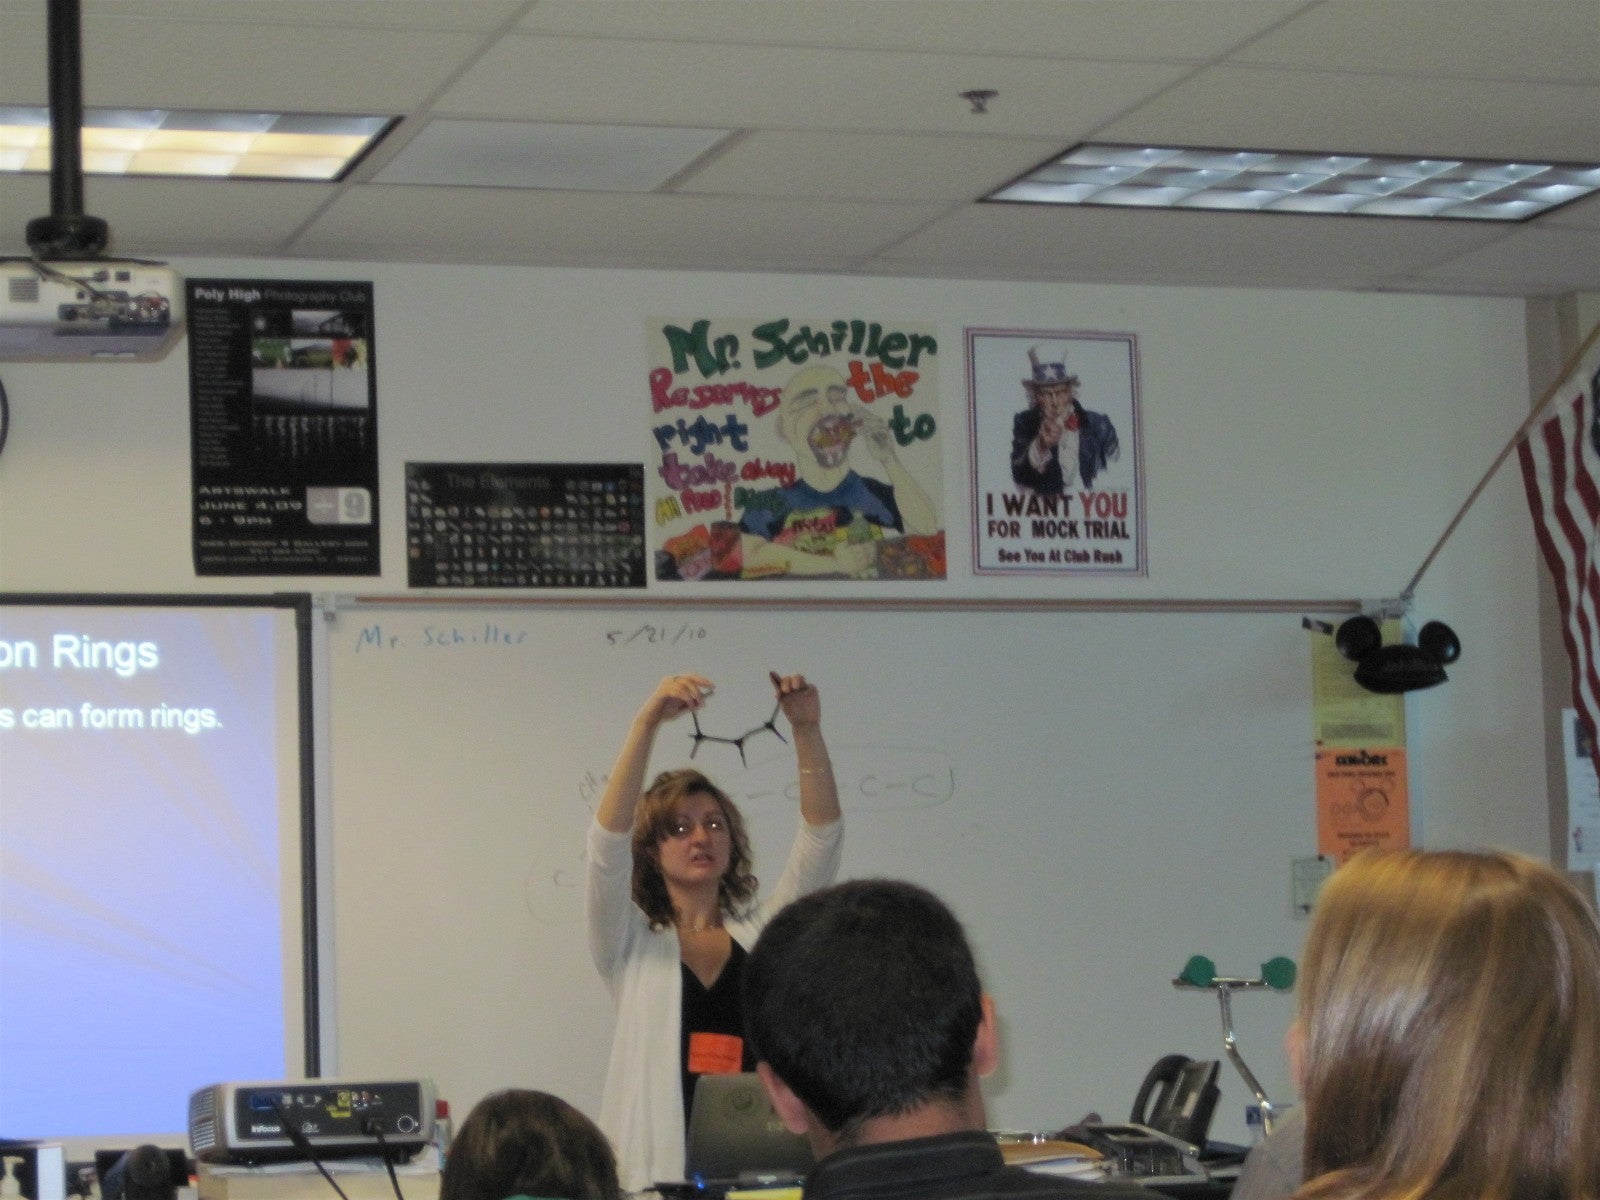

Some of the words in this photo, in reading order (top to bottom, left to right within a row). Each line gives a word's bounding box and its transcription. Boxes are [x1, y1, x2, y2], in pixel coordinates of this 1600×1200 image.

[195, 288, 224, 302] Poly
[229, 289, 261, 304] High
[339, 290, 366, 303] Club
[663, 318, 741, 378] Mr.
[751, 318, 938, 370] Schiller
[846, 361, 920, 403] the
[652, 414, 749, 456] right
[888, 404, 936, 446] to
[986, 493, 994, 516] I
[1002, 494, 1073, 518] WANT
[1079, 493, 1129, 519] YOU
[987, 520, 1021, 538] FOR
[1032, 520, 1079, 538] MOCK
[1084, 520, 1130, 540] TRIAL
[998, 548, 1021, 563] See
[1025, 548, 1045, 563] You
[1049, 549, 1061, 562] At
[1064, 548, 1091, 563] Club
[1094, 549, 1123, 564] Rush
[53, 634, 160, 677] Rings
[22, 706, 73, 728] can
[80, 702, 144, 728] form
[151, 702, 223, 735] rings.
